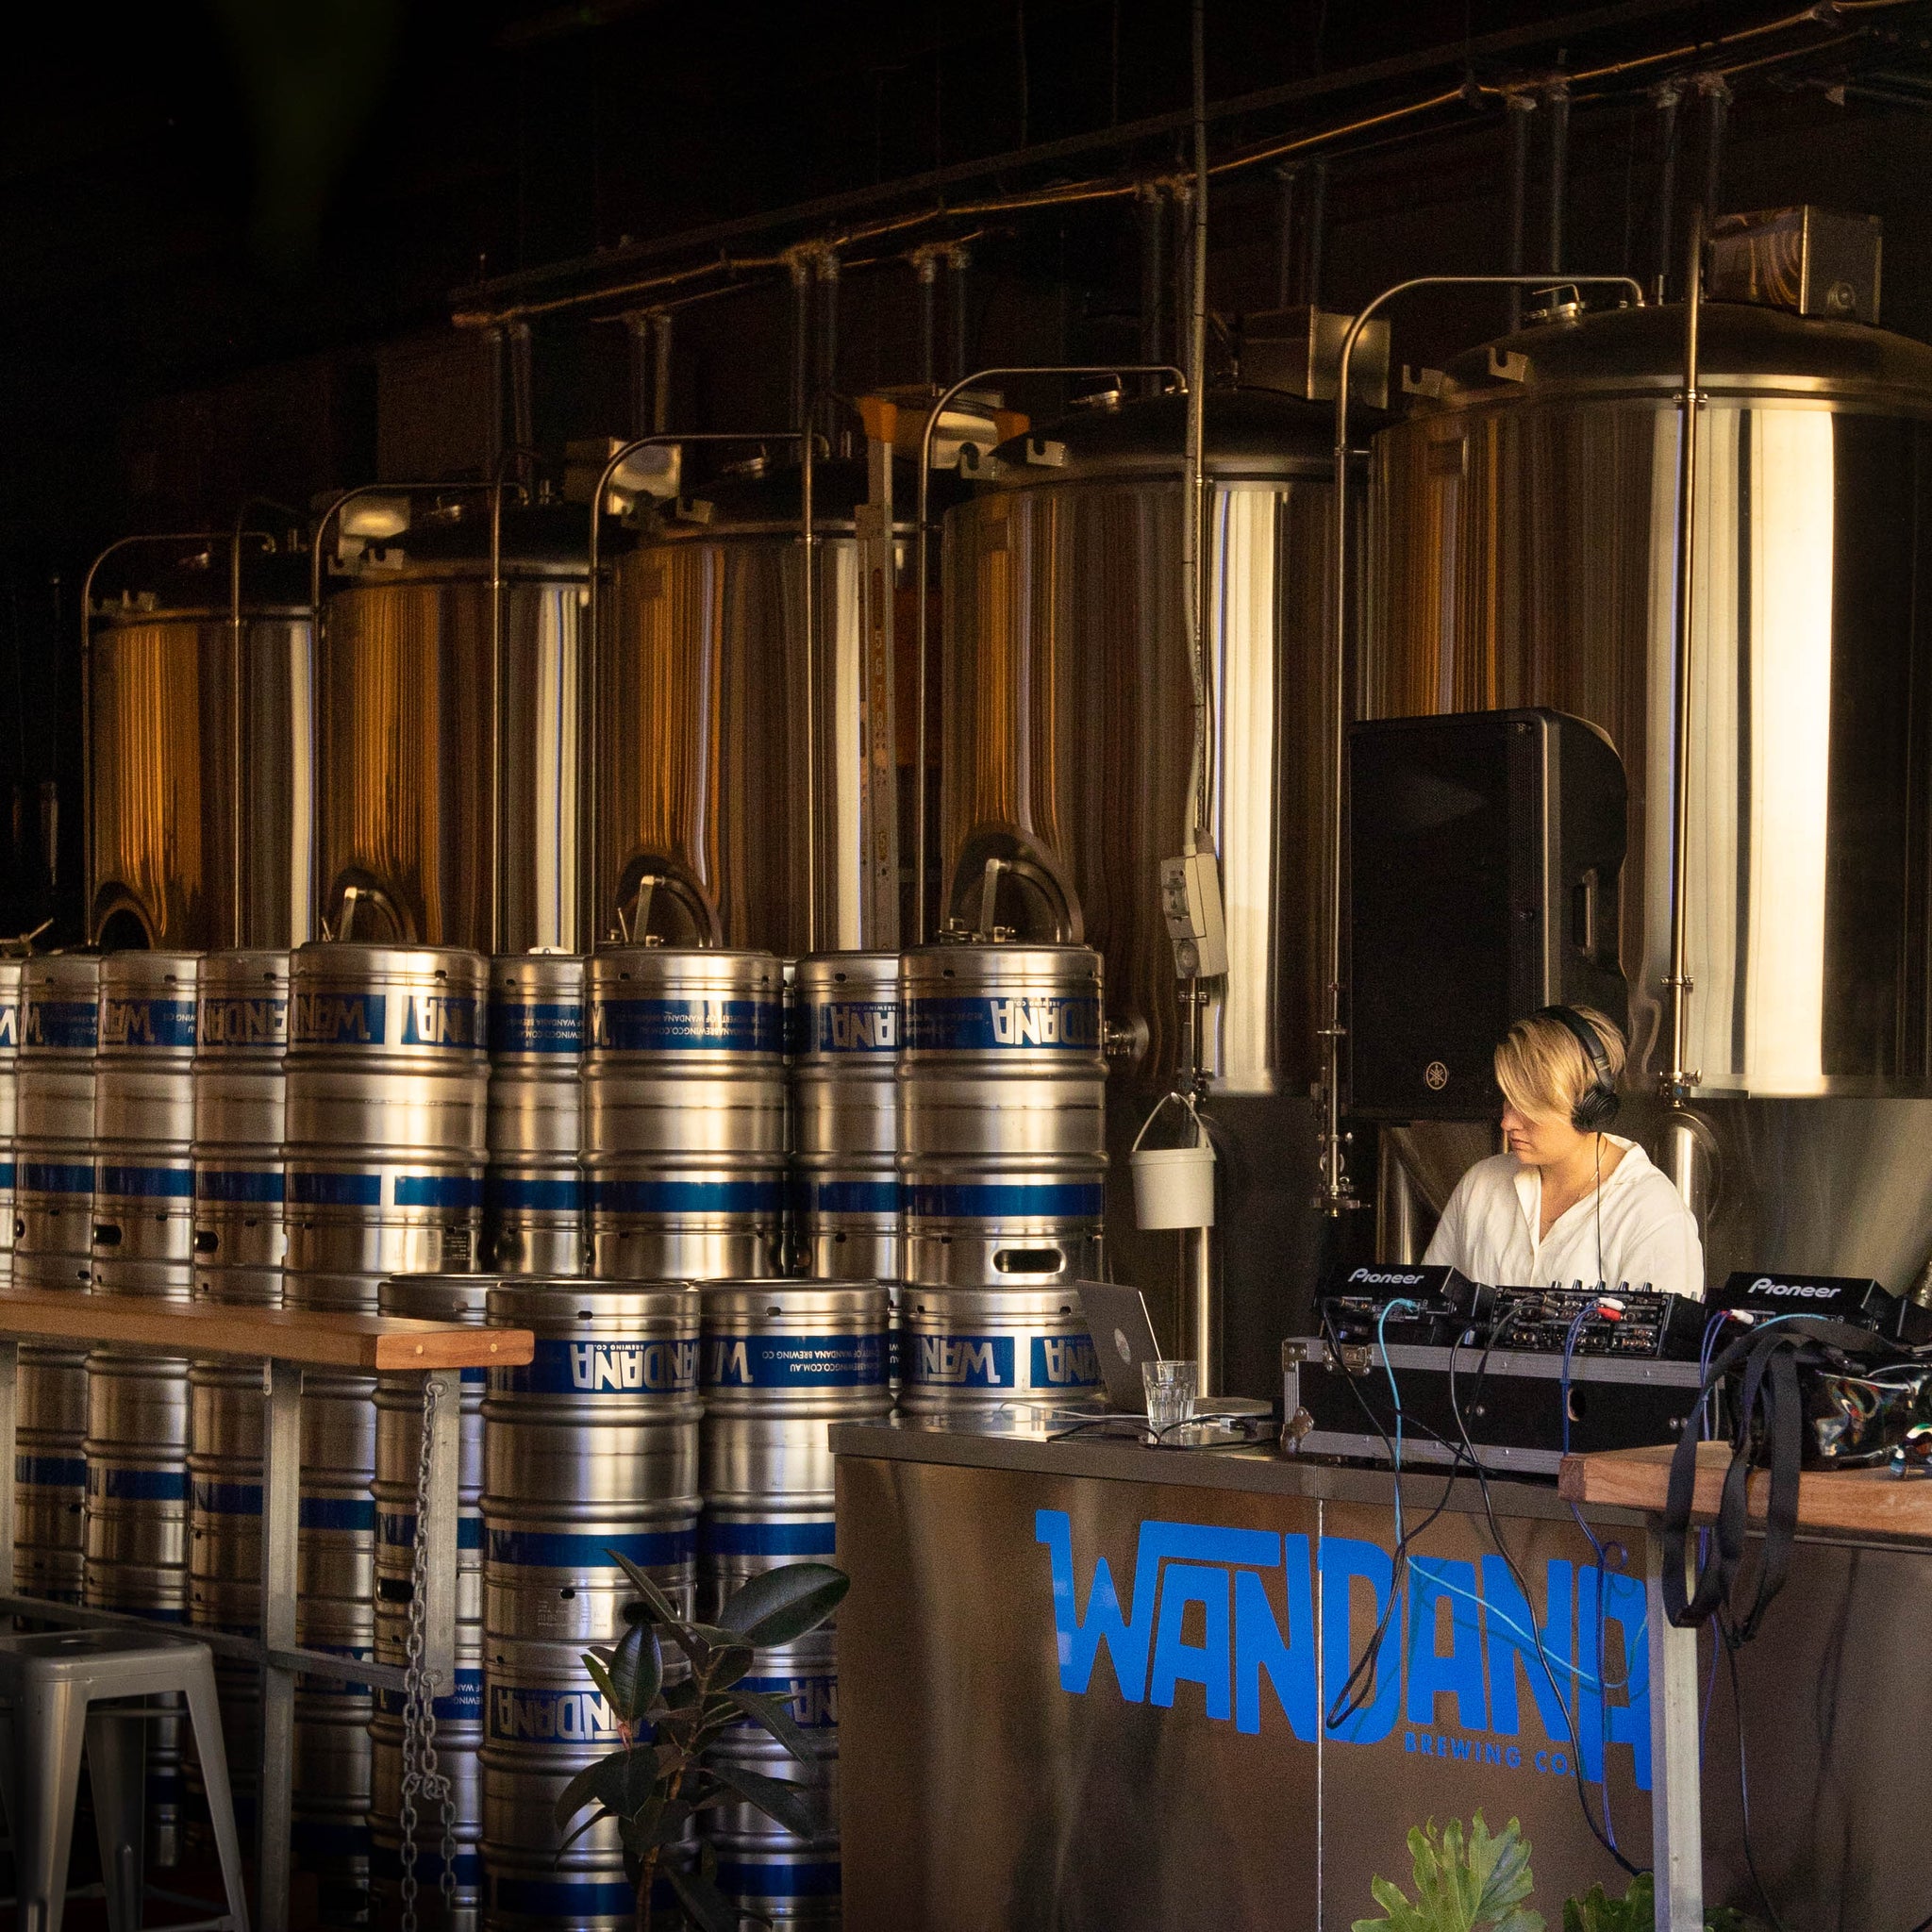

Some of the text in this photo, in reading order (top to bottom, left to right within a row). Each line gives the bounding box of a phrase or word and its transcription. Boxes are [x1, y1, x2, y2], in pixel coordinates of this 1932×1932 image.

[1347, 1267, 1425, 1285] Pioneer
[1747, 1277, 1842, 1299] Pioneer
[776, 1350, 812, 1361] BREWING
[1036, 1510, 1653, 1790] WANDANA
[1405, 1731, 1576, 1778] BREWING CO.
